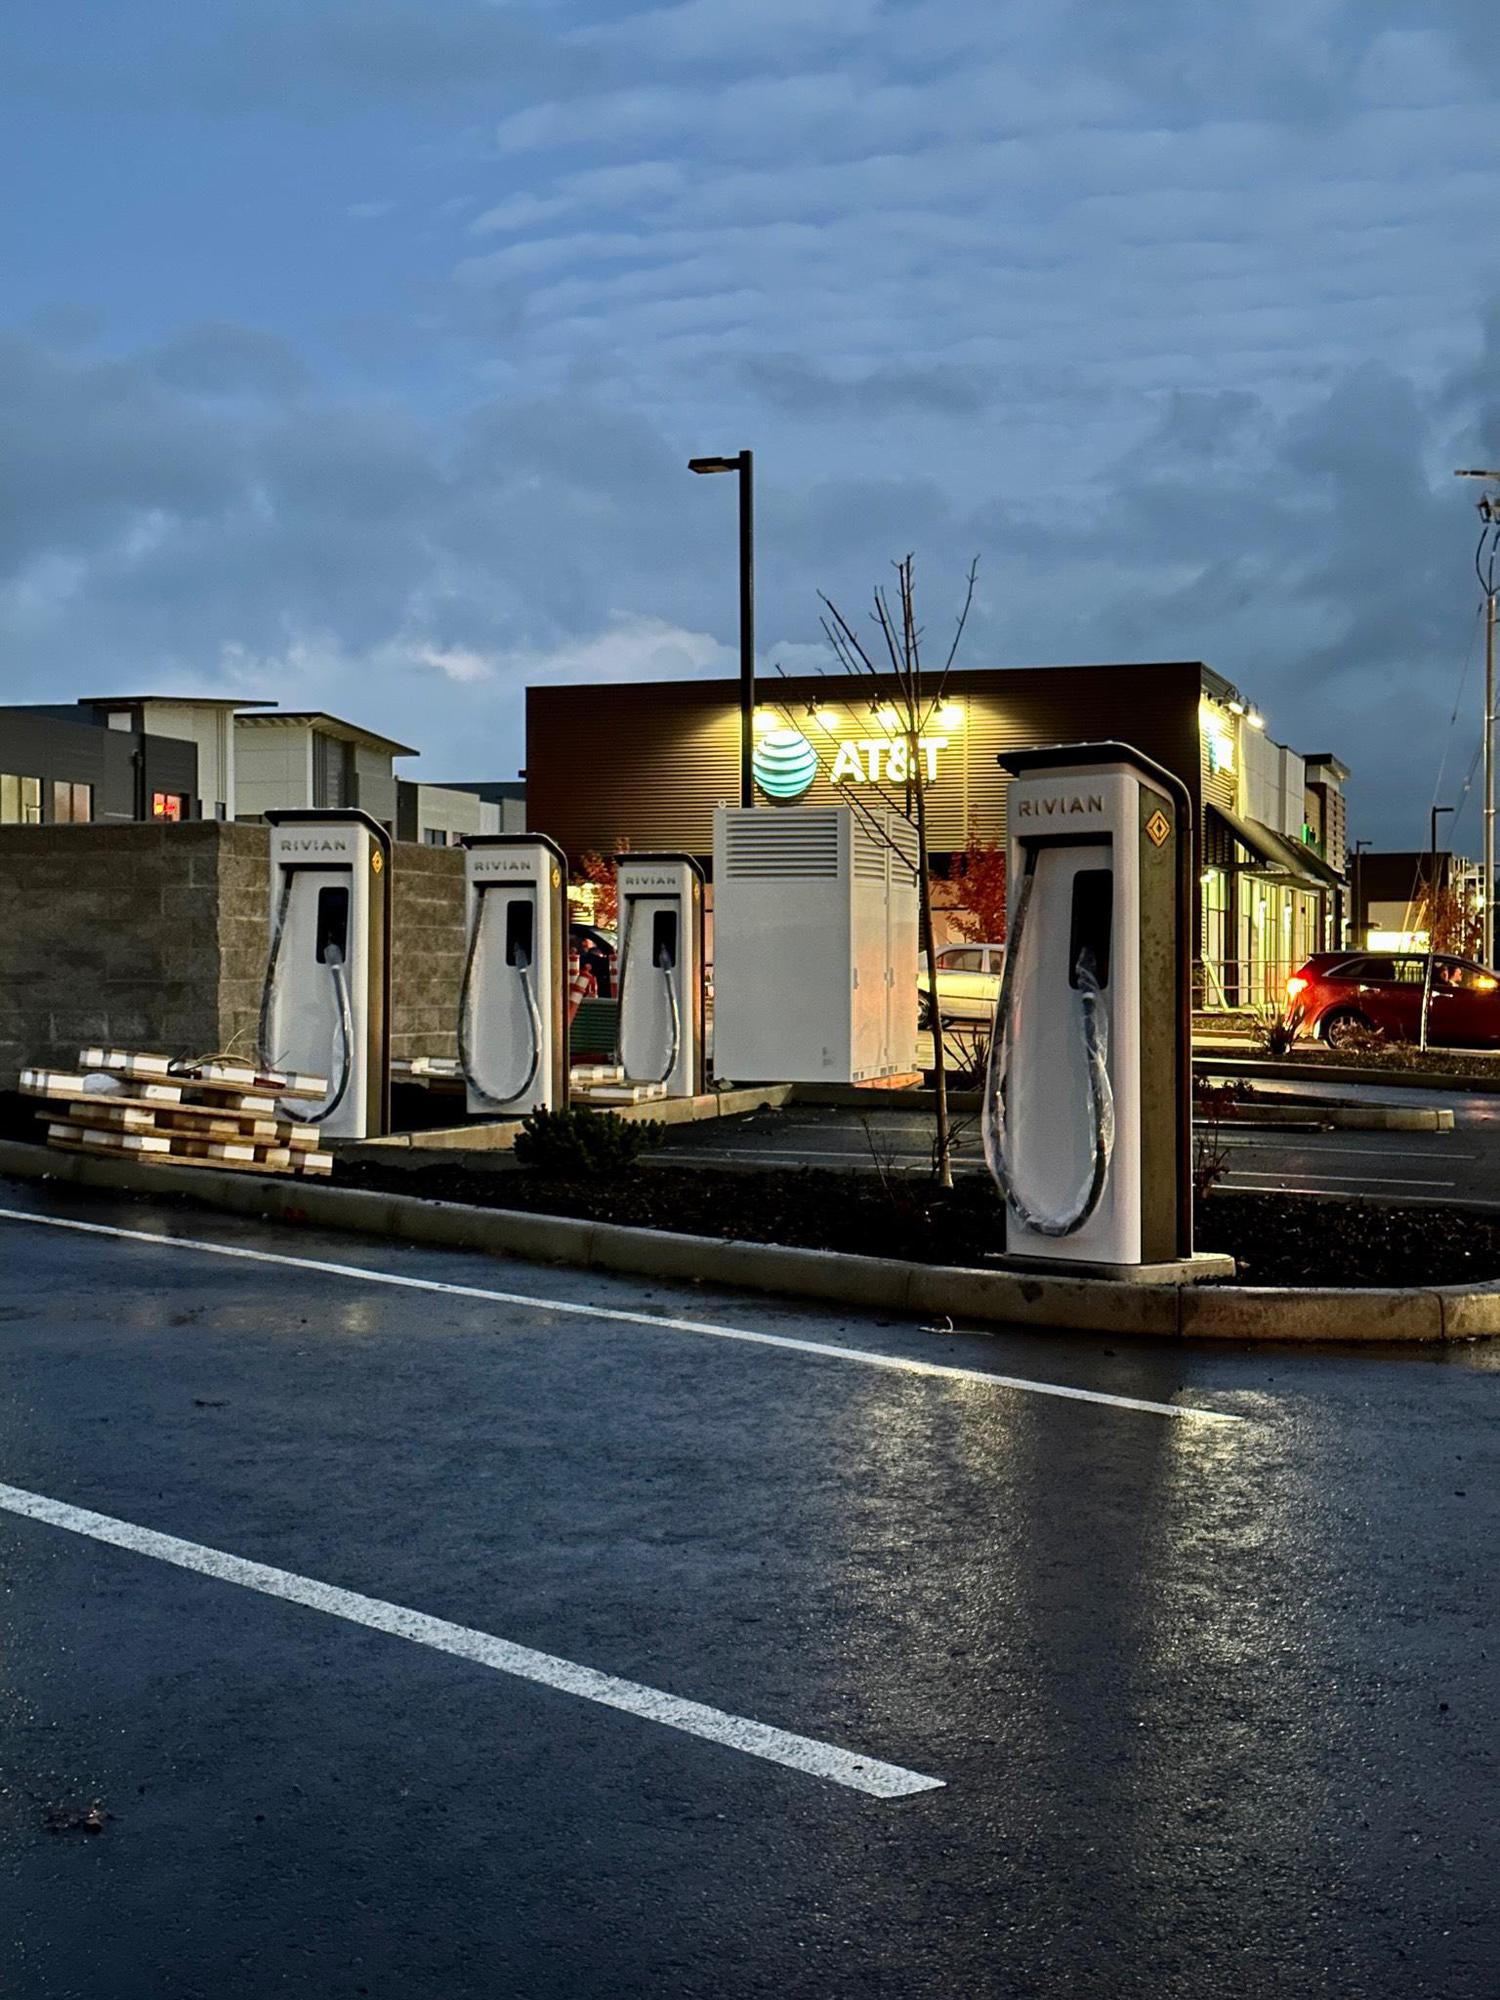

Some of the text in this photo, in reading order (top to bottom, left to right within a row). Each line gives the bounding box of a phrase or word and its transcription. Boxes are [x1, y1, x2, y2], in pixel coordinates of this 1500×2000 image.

[829, 737, 949, 784] AT&T
[1019, 795, 1103, 817] RIVIAN
[281, 840, 346, 851] RIVIAN
[474, 861, 531, 871] RIVIAN
[625, 876, 677, 885] RIVIAN
